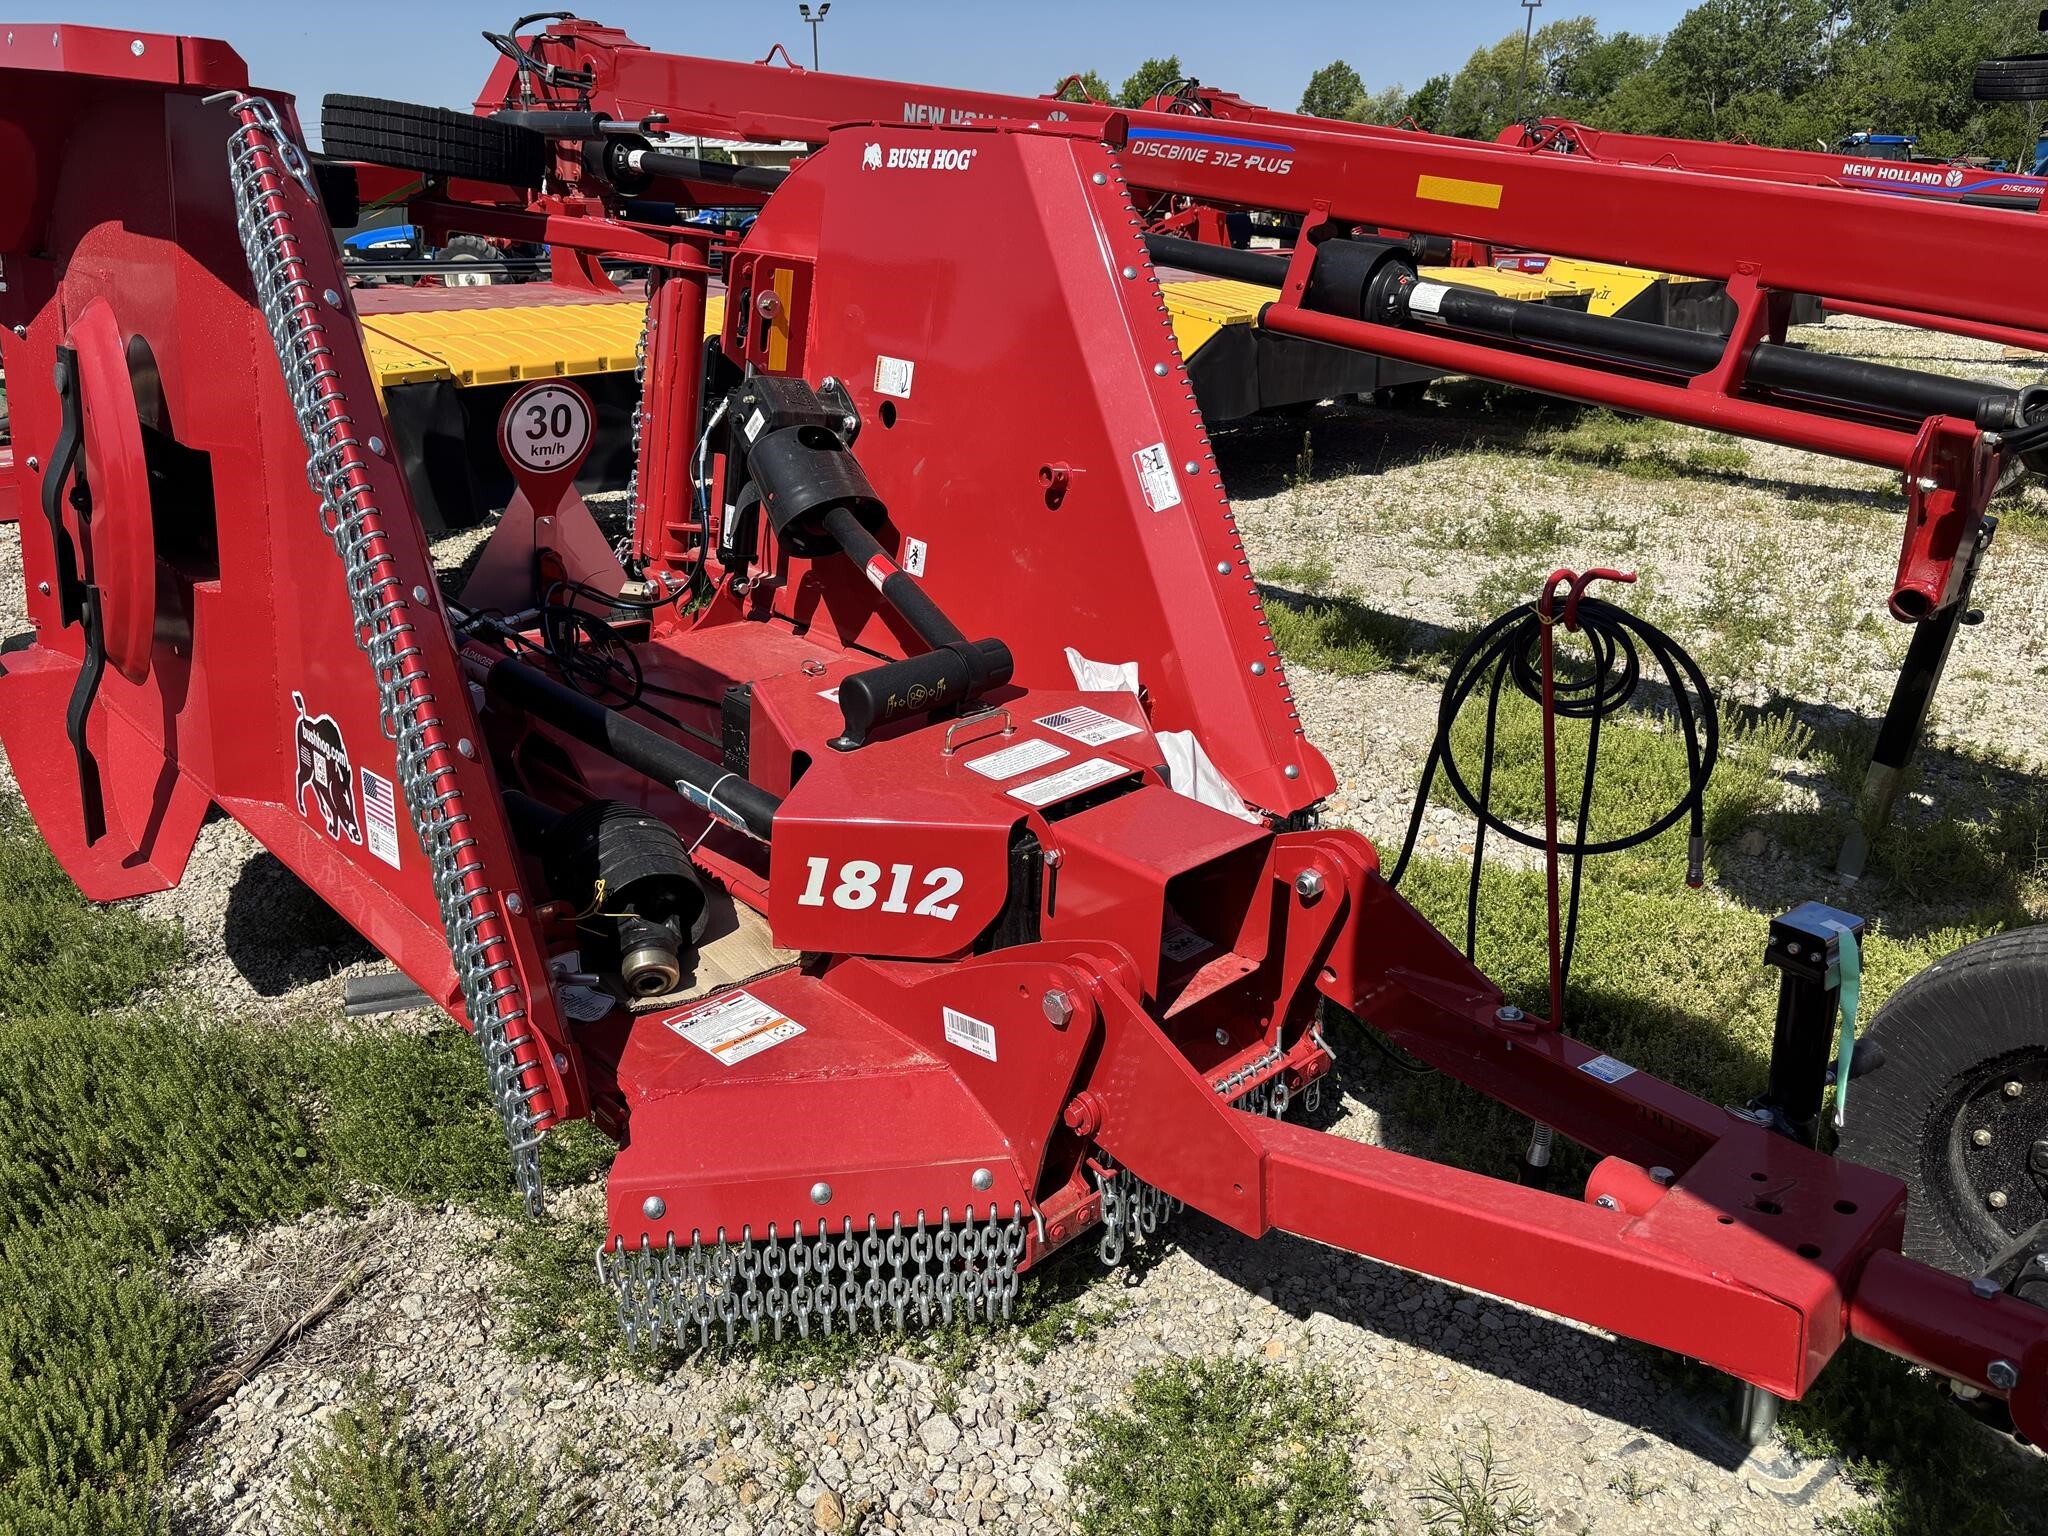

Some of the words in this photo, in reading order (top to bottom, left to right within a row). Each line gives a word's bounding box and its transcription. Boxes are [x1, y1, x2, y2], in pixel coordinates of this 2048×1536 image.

[887, 148, 930, 169] BUSH
[1131, 141, 1209, 163] DISCBINE
[1210, 151, 1242, 168] 312
[1842, 164, 1876, 178] NEW
[1877, 167, 1943, 186] HOLLAND
[525, 403, 572, 440] 30
[530, 442, 565, 457] km/h
[302, 723, 347, 768] bushhog.com
[797, 856, 964, 922] 1812
